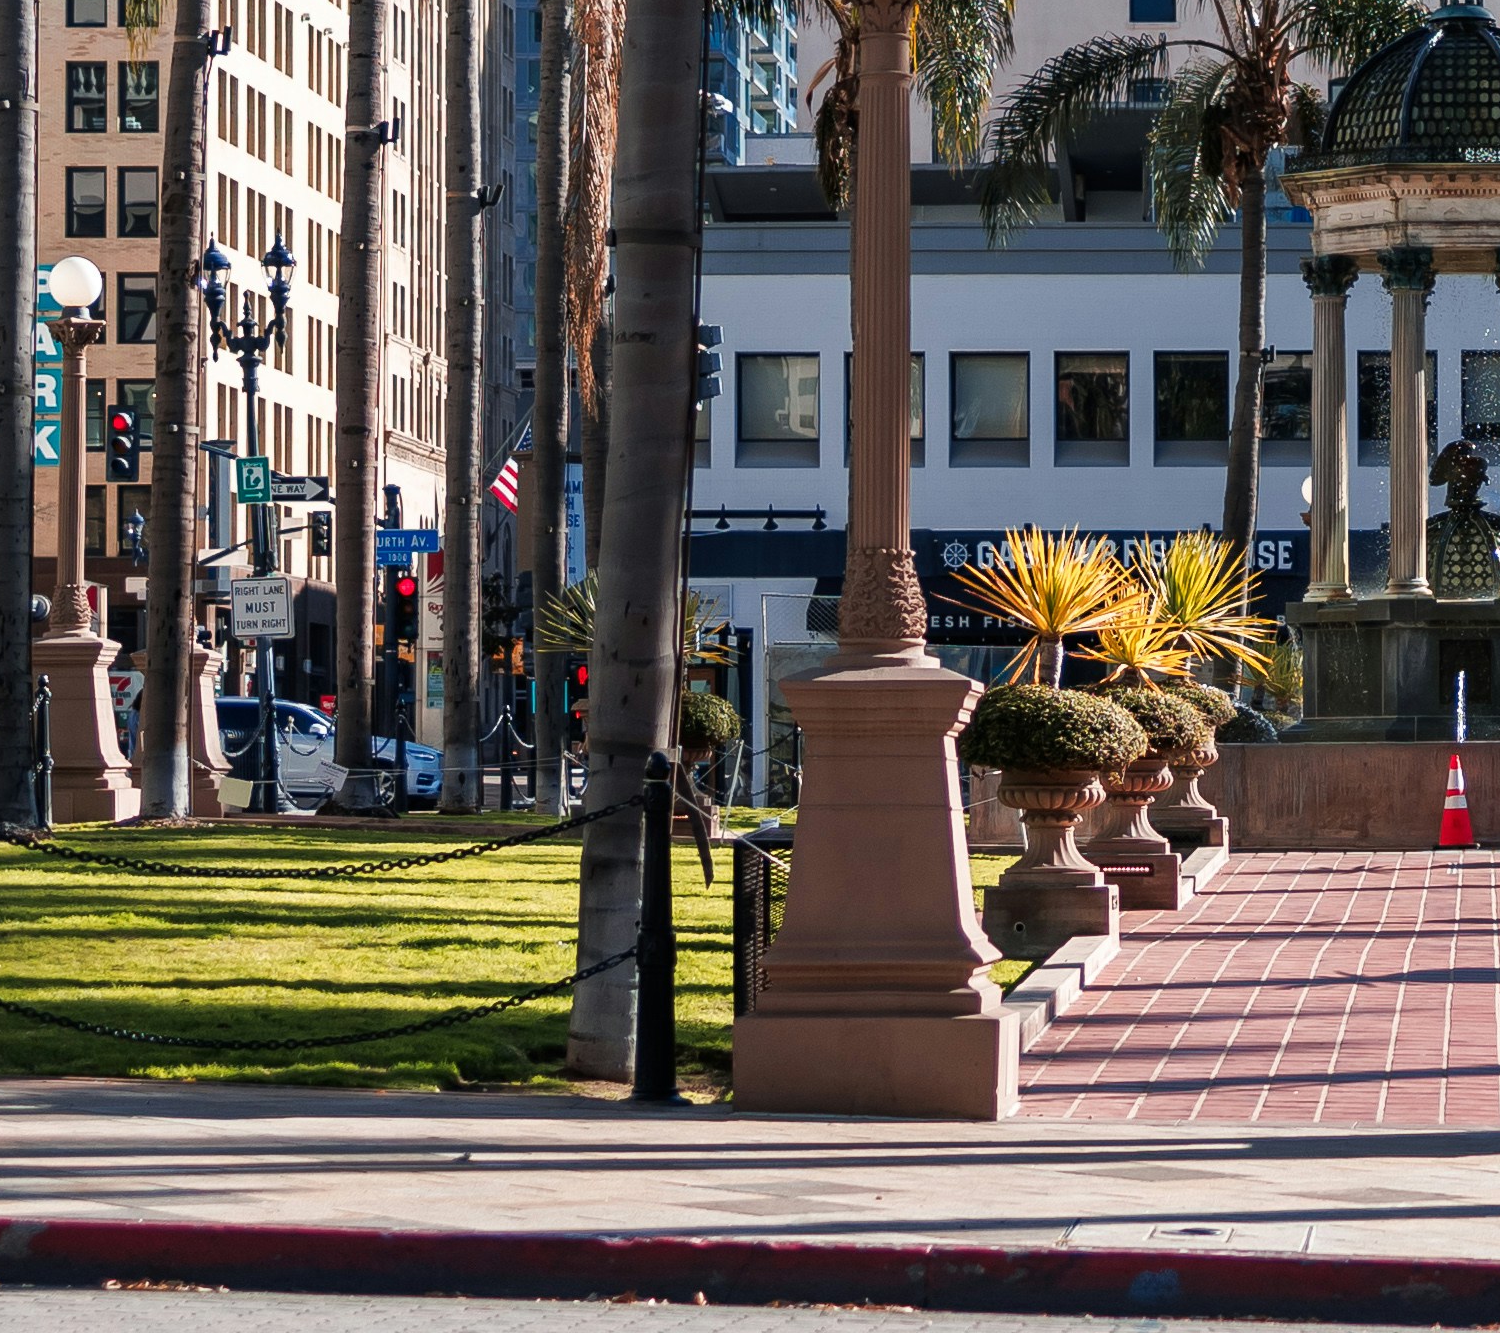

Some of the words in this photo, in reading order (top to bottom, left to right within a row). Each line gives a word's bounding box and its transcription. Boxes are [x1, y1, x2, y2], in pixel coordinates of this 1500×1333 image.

[271, 485, 283, 494] NE
[285, 484, 306, 494] WAY
[377, 536, 405, 547] URTH
[234, 585, 260, 596] RIGHT
[263, 585, 285, 595] LANE
[245, 601, 277, 613] MUST
[236, 619, 259, 630] TURN
[262, 618, 287, 629] RIGHT
[931, 615, 969, 628] ESH
